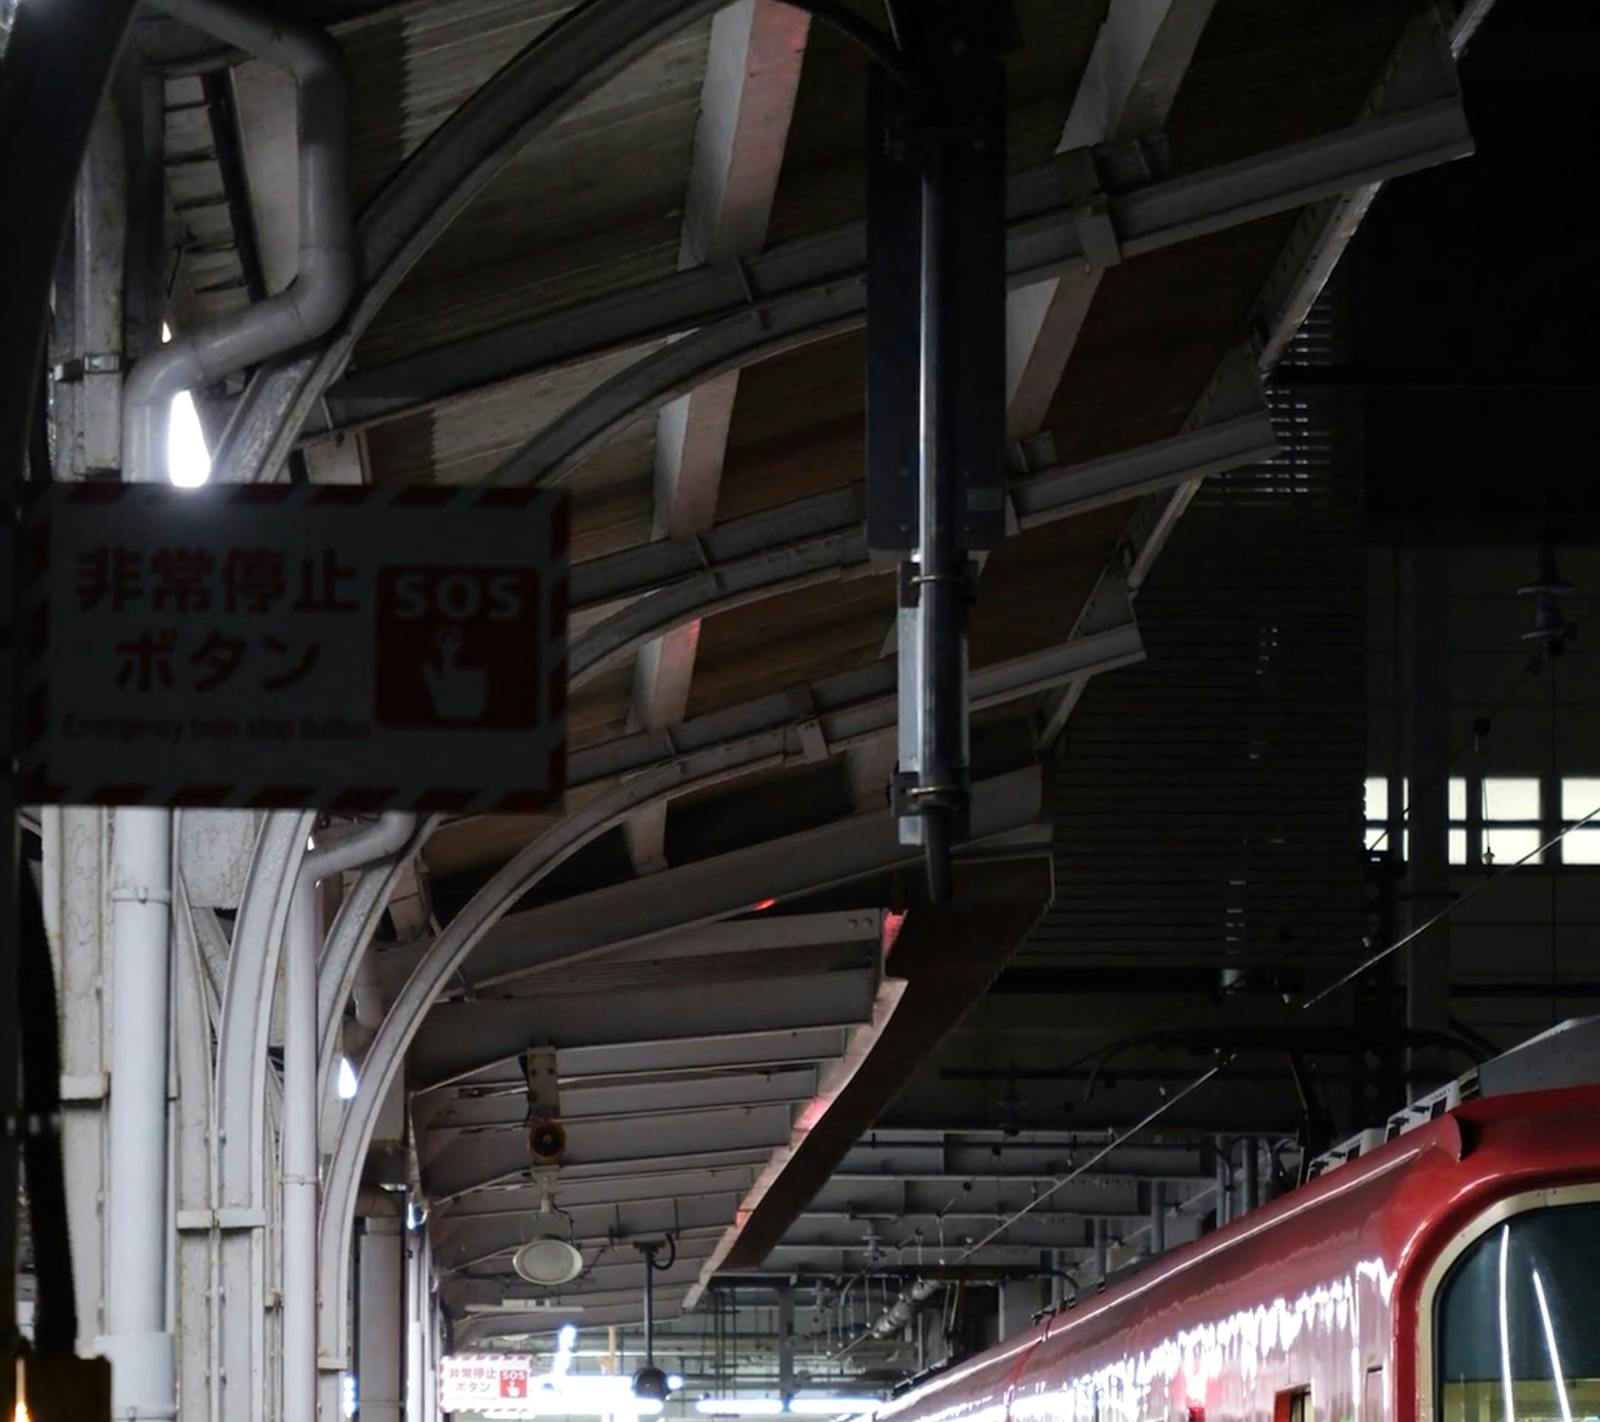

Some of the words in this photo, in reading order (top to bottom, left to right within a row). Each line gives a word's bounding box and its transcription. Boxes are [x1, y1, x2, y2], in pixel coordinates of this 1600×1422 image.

[77, 546, 361, 615] 非常停止
[394, 572, 523, 621] SOS
[114, 628, 323, 693] ボタン
[62, 713, 183, 744] Emergency
[449, 1367, 497, 1379] 非常停止
[456, 1382, 491, 1393] ボタン
[502, 1371, 526, 1381] SOS
